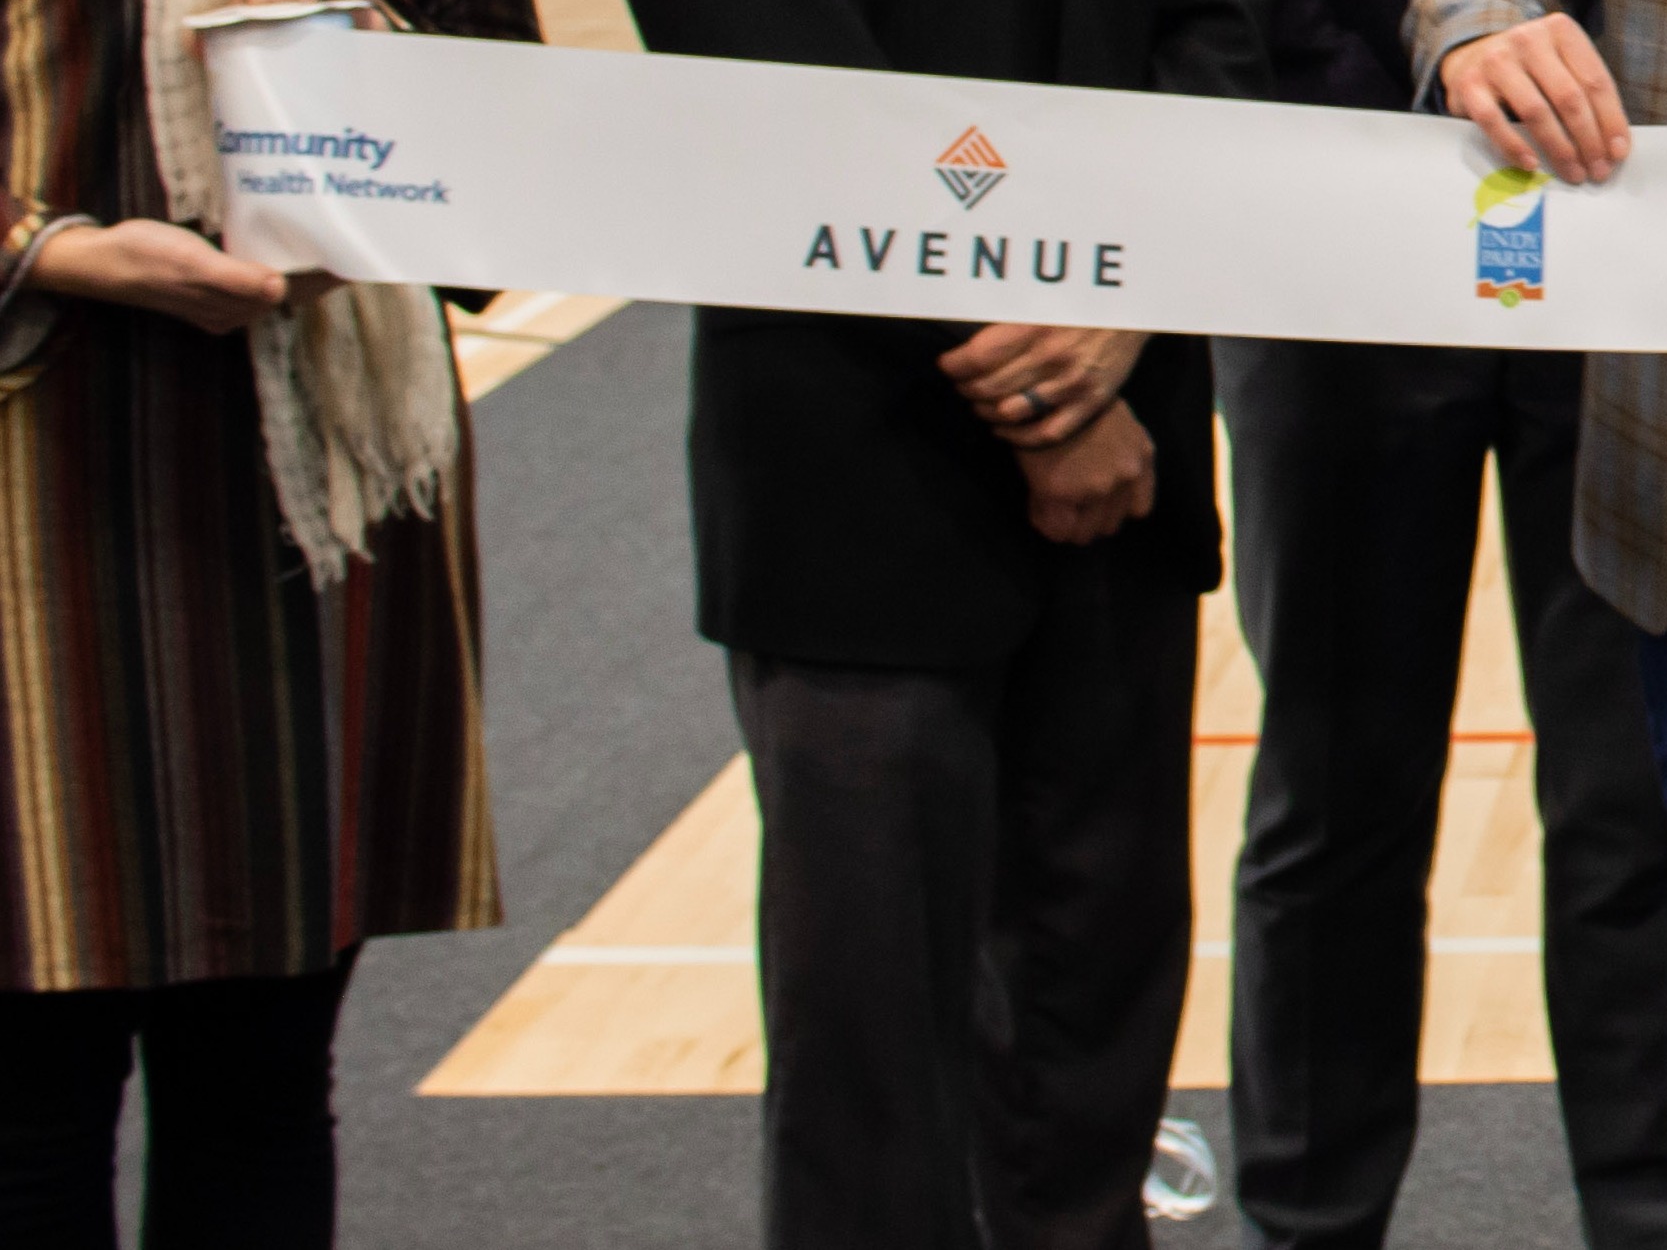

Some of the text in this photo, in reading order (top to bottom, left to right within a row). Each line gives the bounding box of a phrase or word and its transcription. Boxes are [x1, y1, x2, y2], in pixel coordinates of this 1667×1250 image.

[239, 169, 448, 203] Health Network
[803, 224, 1124, 288] AVENUE
